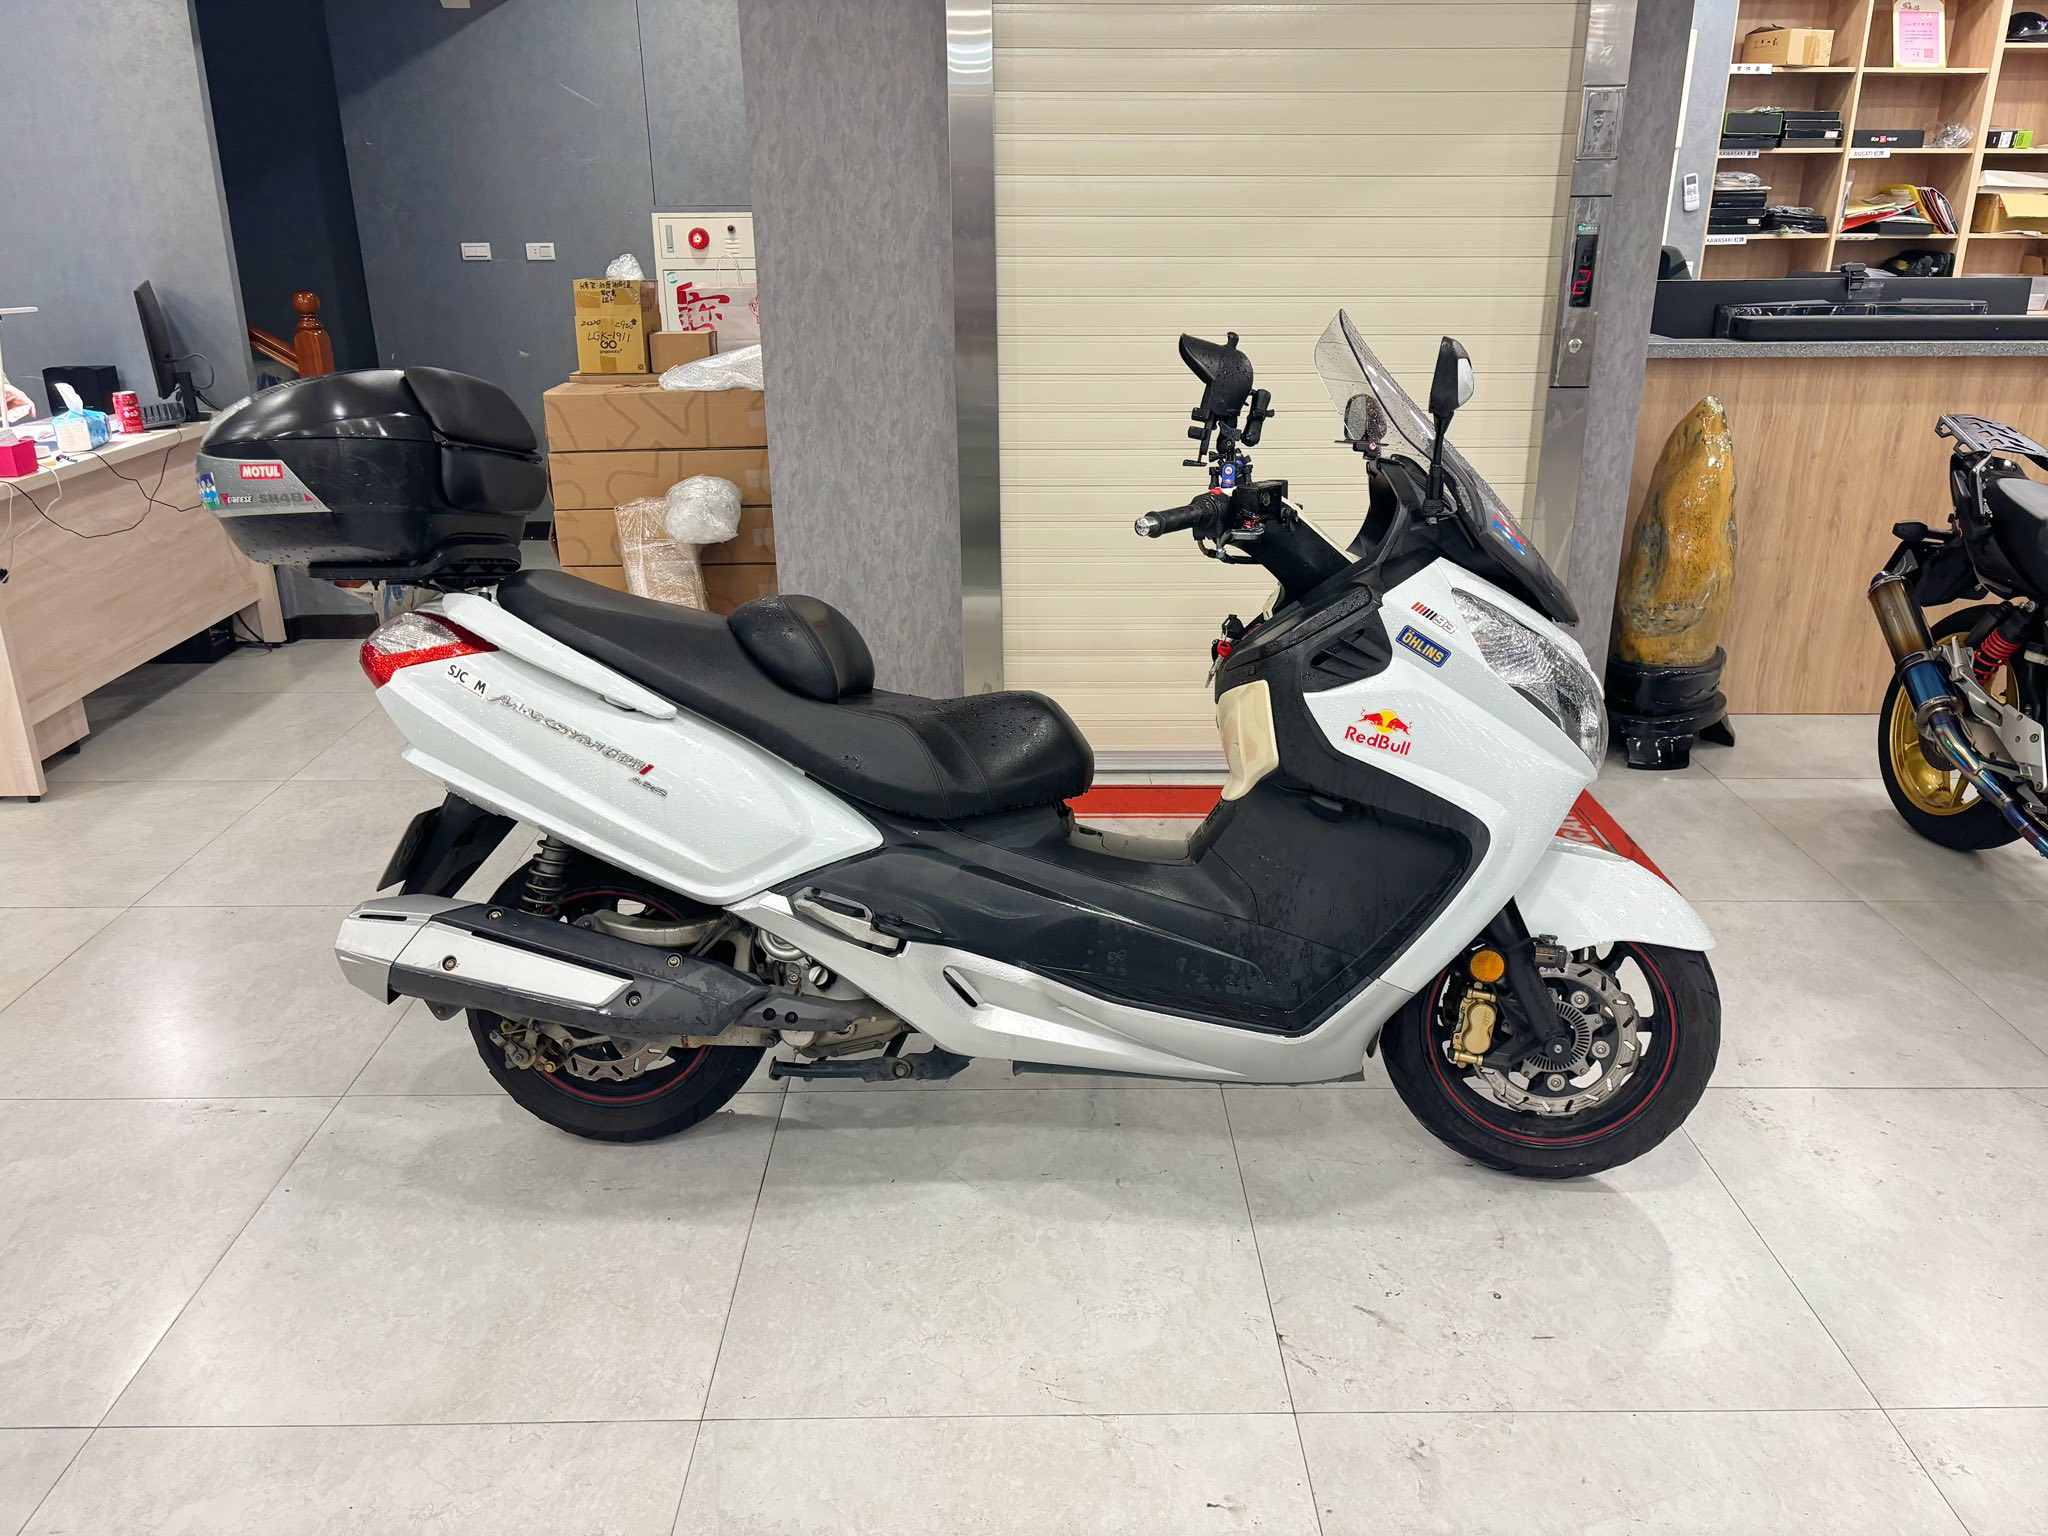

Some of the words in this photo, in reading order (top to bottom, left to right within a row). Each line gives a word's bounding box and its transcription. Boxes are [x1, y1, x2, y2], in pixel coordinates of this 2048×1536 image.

[1572, 269, 1592, 295] 2
[600, 340, 617, 349] GO
[242, 465, 281, 478] MOTUL
[1401, 629, 1446, 664] ÖHLINS
[446, 664, 470, 684] SJC
[473, 679, 488, 695] M
